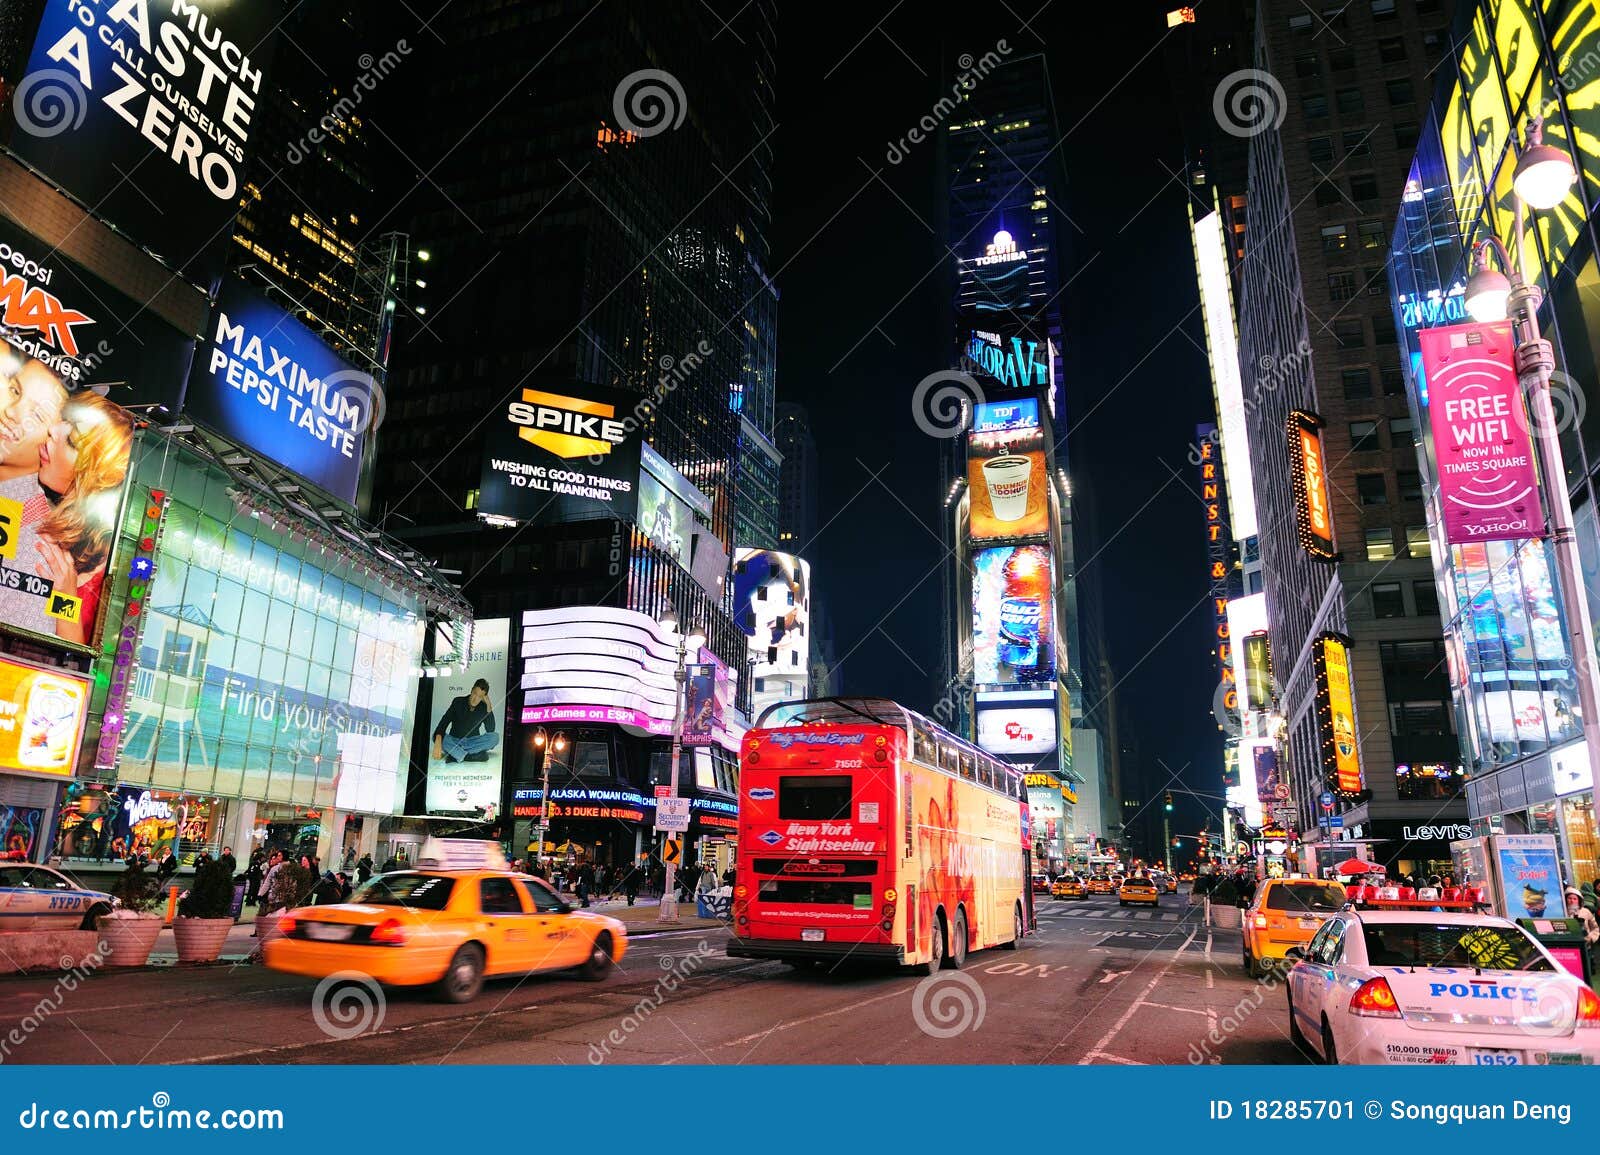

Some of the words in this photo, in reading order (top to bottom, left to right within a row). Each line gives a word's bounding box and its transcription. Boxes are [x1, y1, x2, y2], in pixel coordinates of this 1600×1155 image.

[171, 0, 262, 94] MUCH
[107, 0, 255, 142] ASTE
[98, 25, 147, 79] CALL
[151, 73, 243, 163] OURSELVES
[47, 26, 92, 90] A
[101, 62, 237, 200] ZERO
[975, 250, 1027, 266] TOSHIBA
[215, 312, 360, 432] MAXIMUM
[209, 347, 278, 411] PEPSI
[286, 397, 356, 459] TASTE
[1445, 394, 1511, 422] FREE
[508, 402, 625, 444] SPIKE
[1452, 420, 1510, 446] WIFI
[1462, 447, 1489, 458] NOW
[1492, 445, 1504, 455] IN
[1444, 461, 1480, 474] TIMES
[1482, 456, 1527, 471] SQUARE
[491, 459, 547, 478] WISHING
[548, 467, 586, 485] GOOD
[587, 475, 631, 492] THINGS
[509, 474, 527, 488] TO
[528, 477, 551, 491] ALL
[552, 482, 613, 501] MANKIND.
[1201, 442, 1220, 541] ERNST
[1462, 520, 1527, 535] YAHOO!
[609, 521, 620, 576] 1500
[1212, 562, 1226, 580] &
[52, 594, 77, 618] MTV
[1001, 603, 1042, 616] BUD
[1215, 599, 1238, 709] YOUNG
[220, 677, 279, 722] Find
[281, 700, 332, 733] your
[543, 709, 550, 719] X
[551, 709, 586, 719] Games
[588, 710, 604, 719] on
[607, 709, 636, 722] ESPN
[683, 734, 712, 743] MEMPHIS
[834, 759, 862, 769] 71502
[1024, 773, 1047, 786] EATS
[551, 789, 587, 799] ALASKA
[588, 790, 621, 800] WOMAN
[642, 797, 657, 806] CHIL
[693, 799, 711, 809] AFTER
[514, 806, 547, 816] HANDLE
[565, 808, 571, 816] 3
[573, 808, 599, 817] DUKE
[601, 808, 610, 817] IN
[658, 812, 686, 820] SECURITY
[786, 822, 817, 836] New
[820, 822, 852, 836] York
[785, 838, 876, 855] Sightseeing
[48, 896, 81, 909] NYPD
[1430, 983, 1538, 1002] POLICE
[1422, 1047, 1458, 1056] REWARD
[1475, 1055, 1518, 1065] 1952
